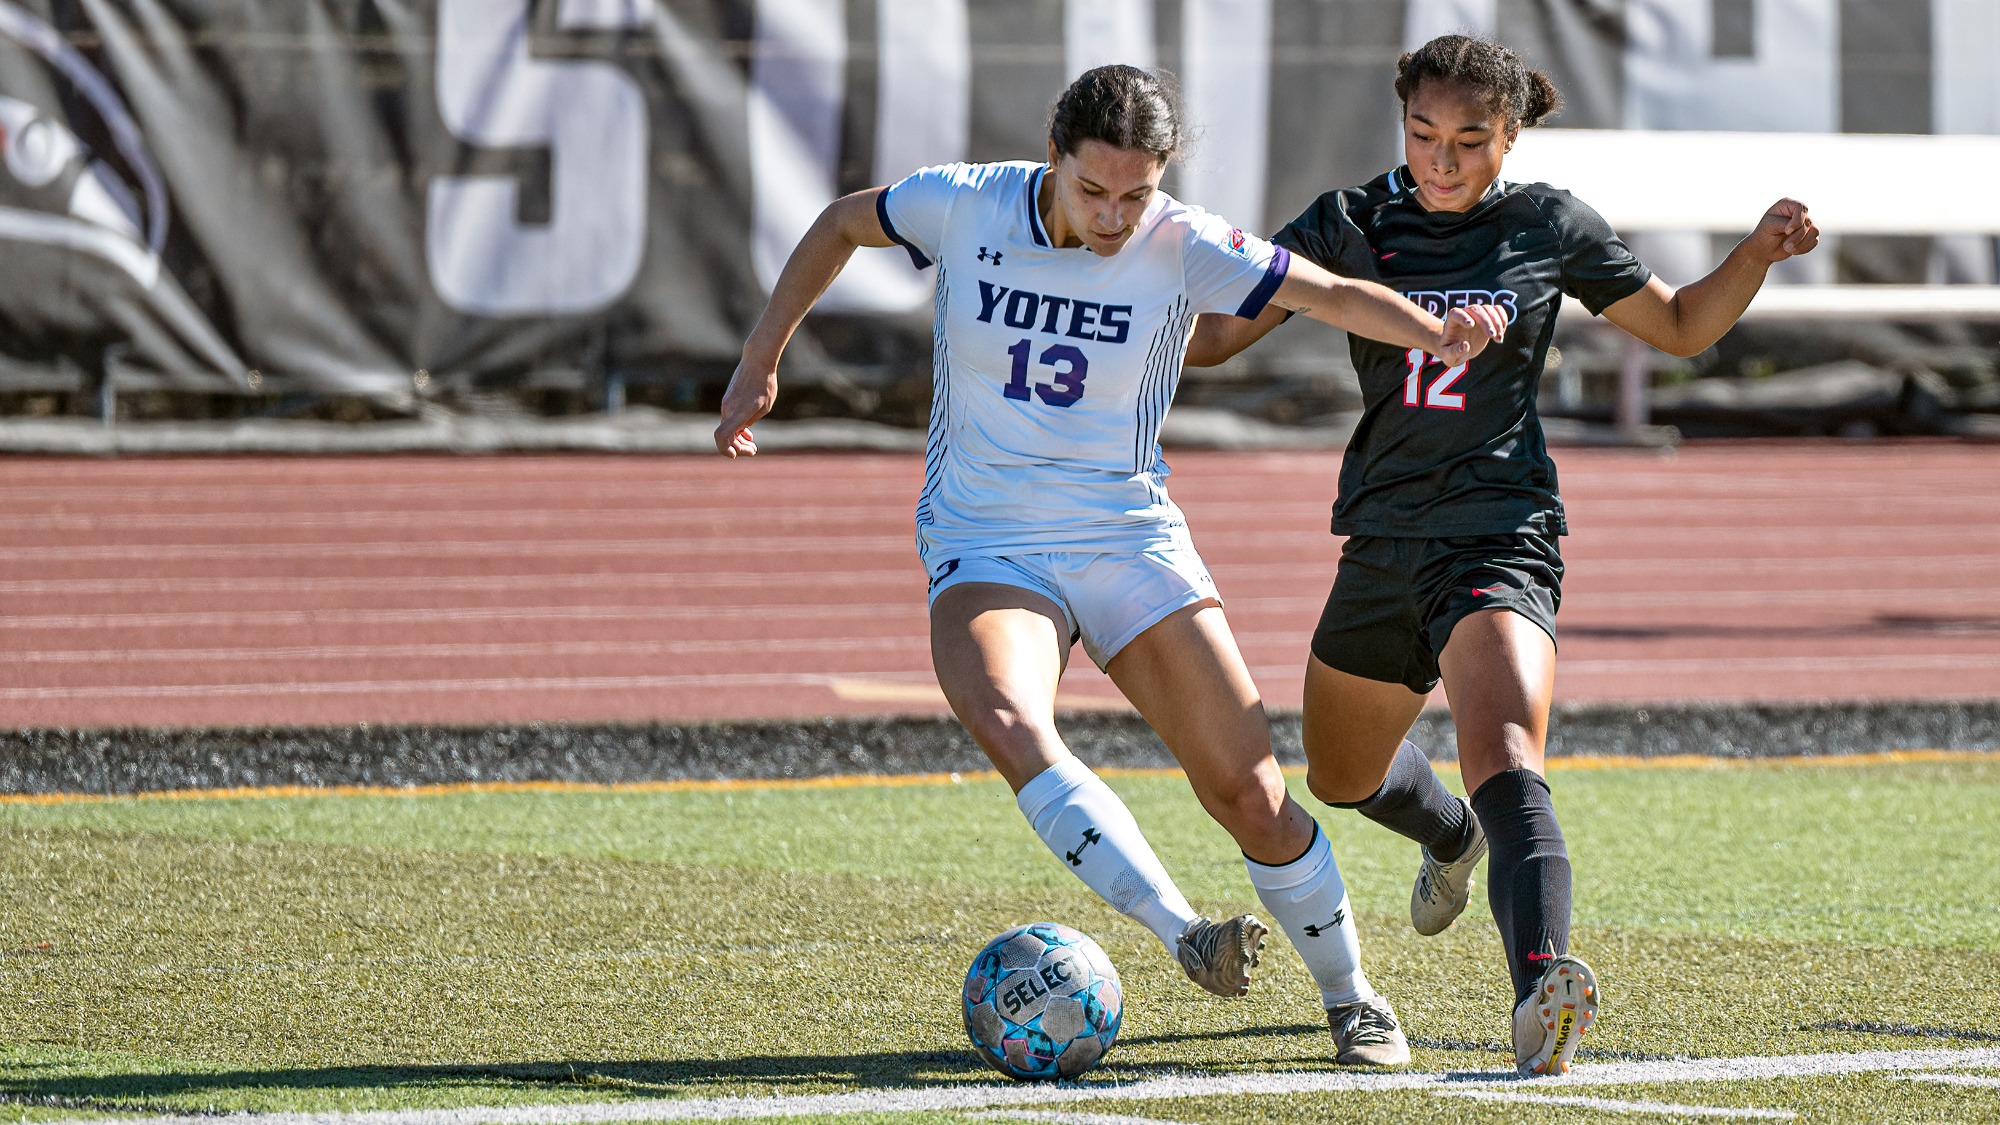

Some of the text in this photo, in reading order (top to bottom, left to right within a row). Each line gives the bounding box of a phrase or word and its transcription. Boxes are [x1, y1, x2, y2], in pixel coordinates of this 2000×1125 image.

[976, 280, 1132, 344] YOTES
[1003, 339, 1088, 408] 13
[1403, 346, 1469, 411] 12
